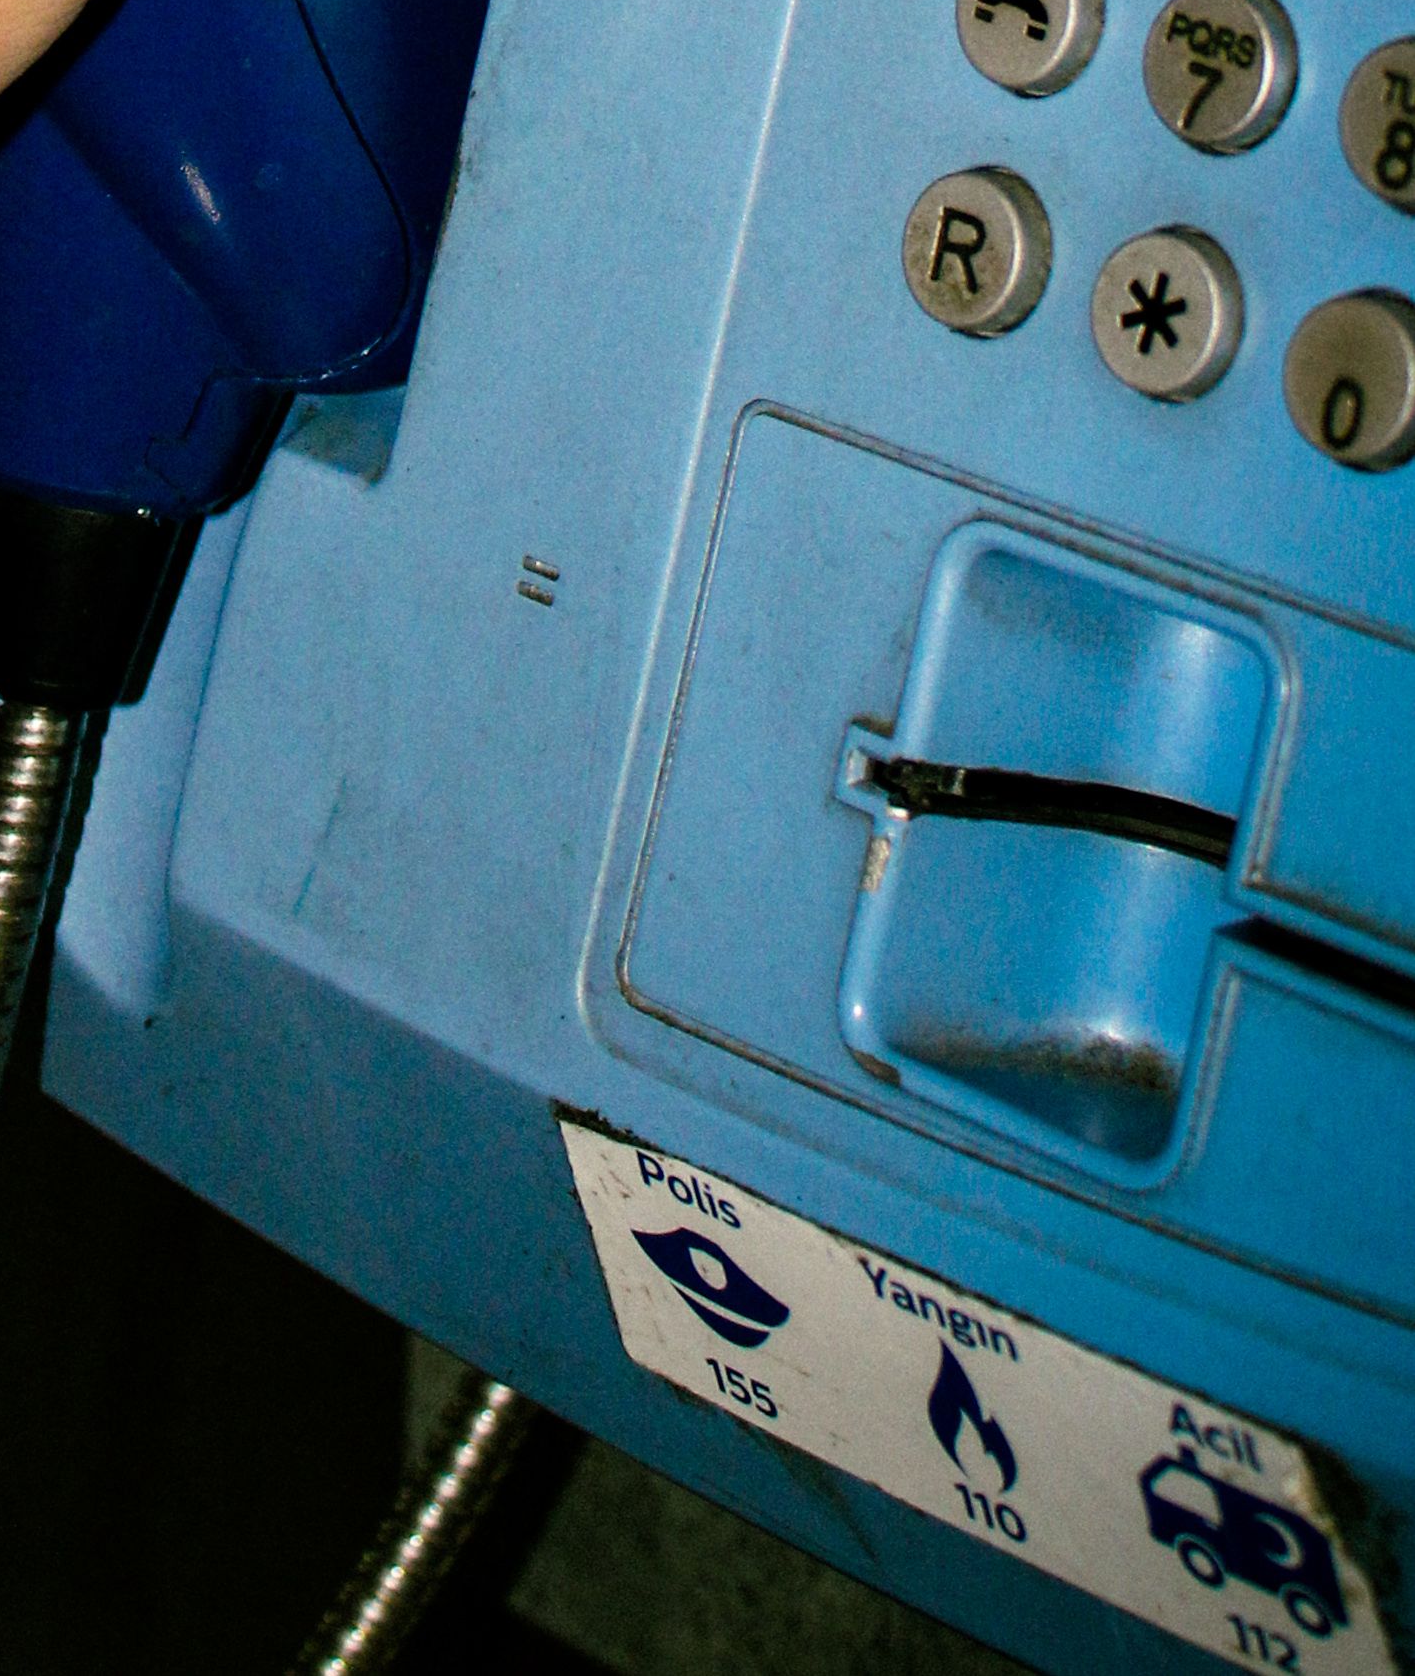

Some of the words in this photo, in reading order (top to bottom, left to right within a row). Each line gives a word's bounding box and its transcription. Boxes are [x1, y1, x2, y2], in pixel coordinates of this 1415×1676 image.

[1166, 11, 1255, 68] PQRS
[1182, 61, 1223, 129] 7
[1375, 120, 1415, 190] 8
[929, 205, 986, 295] R
[1323, 377, 1362, 449] 0
[636, 1149, 741, 1229] Polis
[705, 1358, 778, 1419] 155
[1169, 1403, 1262, 1473] Acil
[954, 1481, 1027, 1541] 110
[1226, 1613, 1298, 1674] 112
